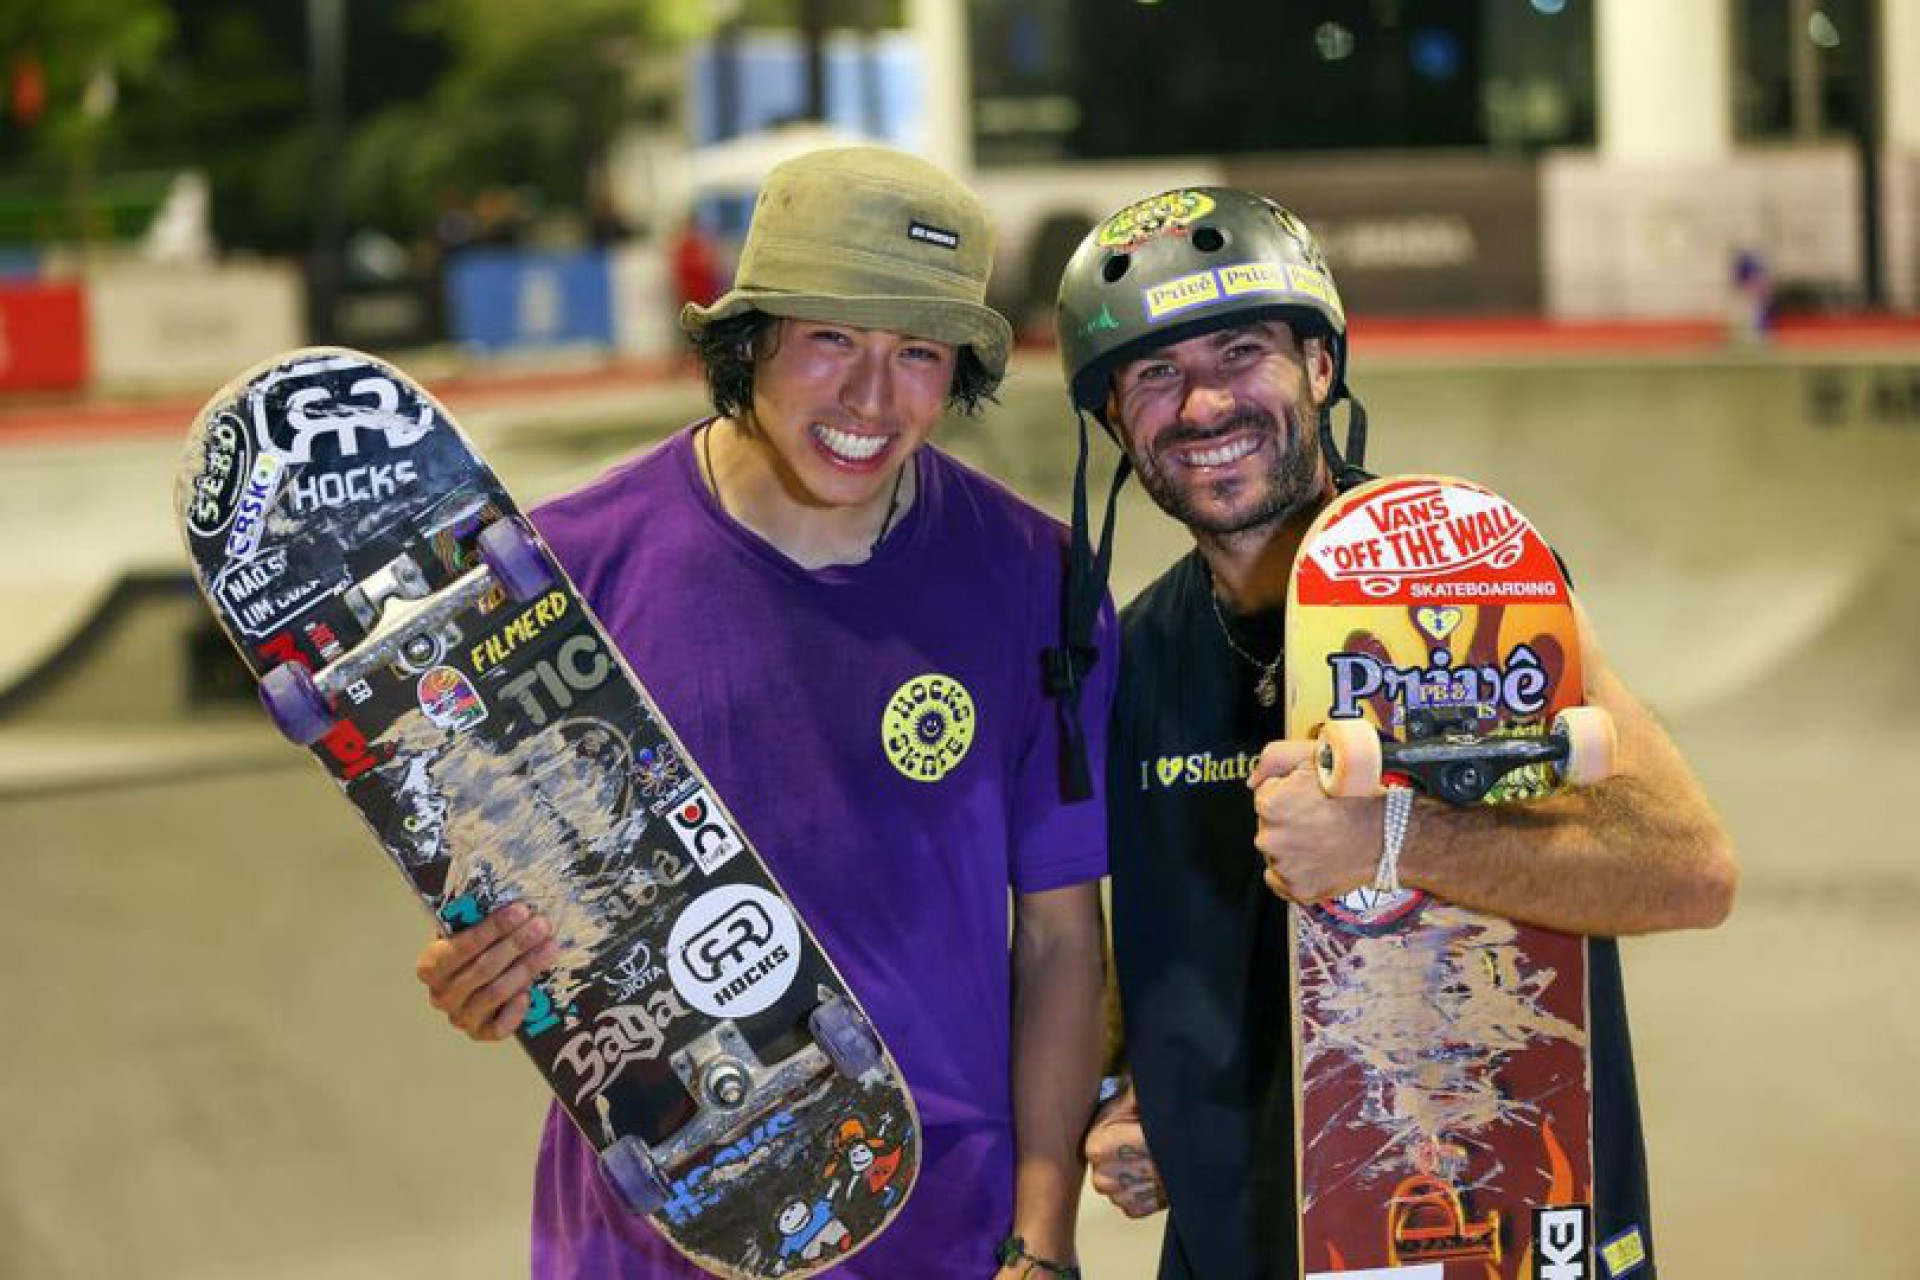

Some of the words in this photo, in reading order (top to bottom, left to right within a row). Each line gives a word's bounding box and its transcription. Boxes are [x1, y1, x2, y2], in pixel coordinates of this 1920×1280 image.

[1366, 497, 1449, 532] VANS
[1386, 523, 1451, 567] THE
[1449, 504, 1520, 557] WALL
[1409, 581, 1556, 597] SKATEBOARDING
[470, 592, 568, 673] FILMERD
[499, 635, 609, 727] TIC
[892, 679, 971, 722] HOCKS
[1326, 643, 1549, 718] Privê
[888, 735, 963, 775] SKATE
[1140, 761, 1150, 790] I
[712, 944, 791, 1007] HOCKS
[551, 986, 692, 1105] Saga
